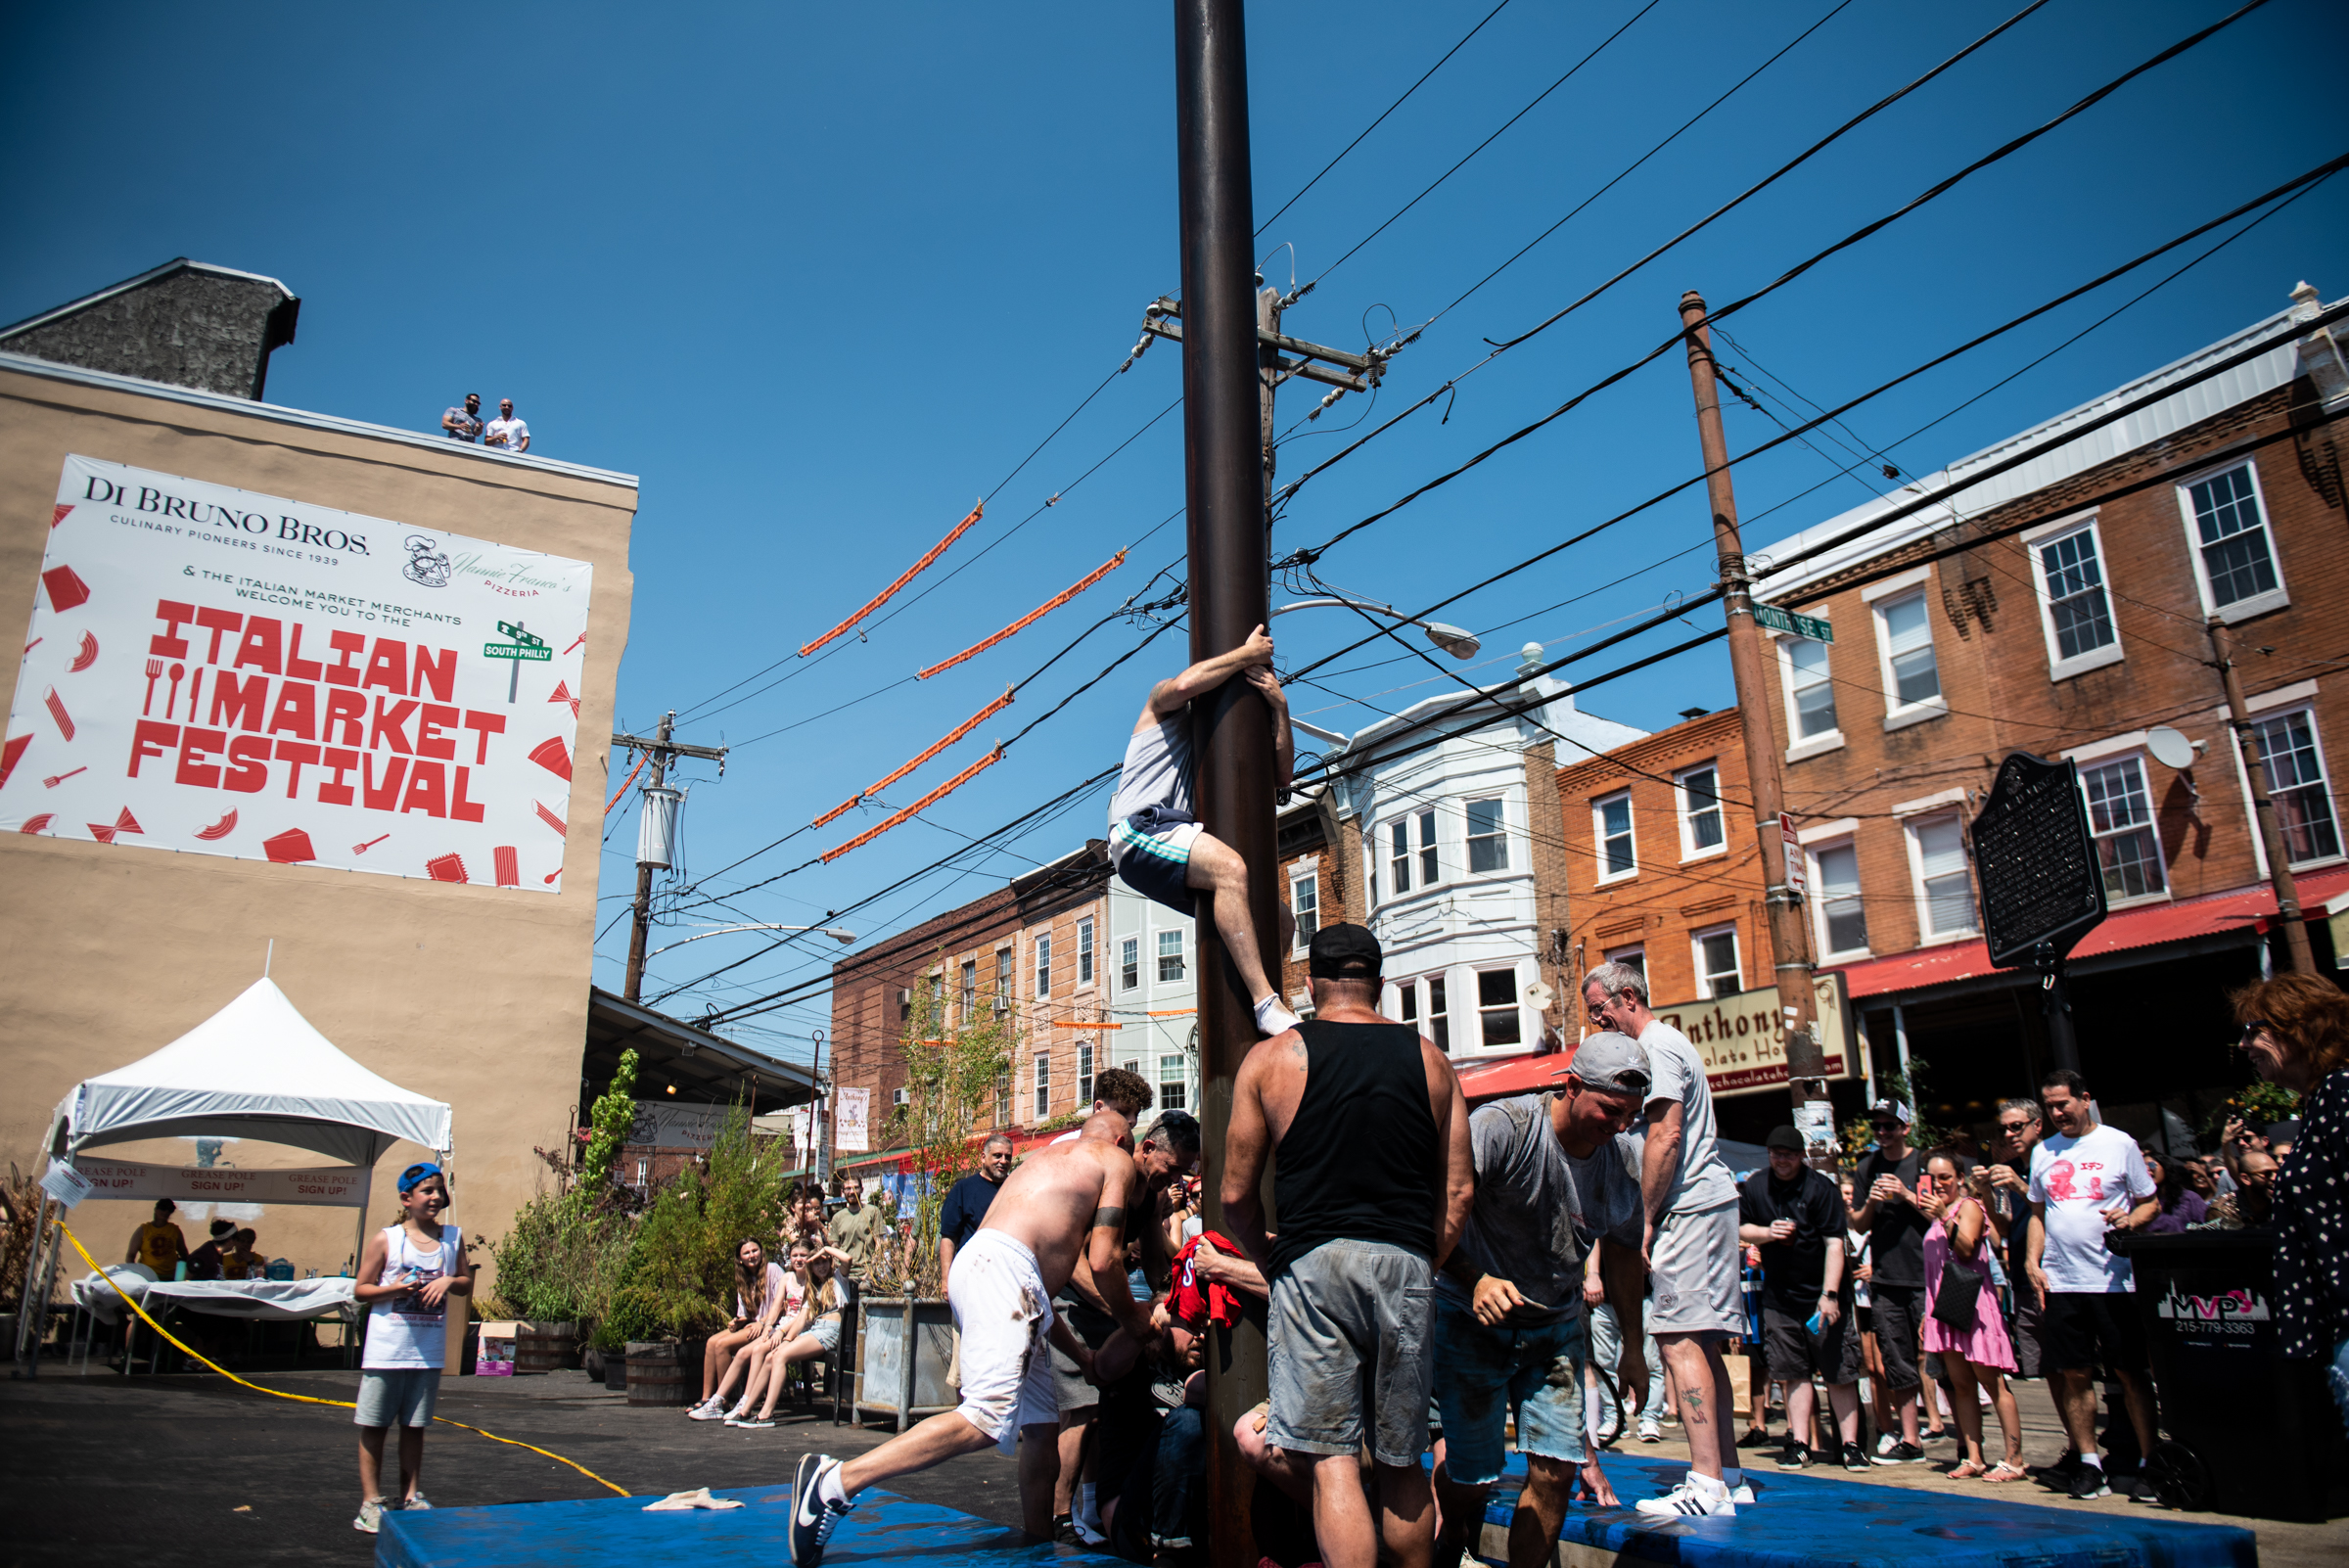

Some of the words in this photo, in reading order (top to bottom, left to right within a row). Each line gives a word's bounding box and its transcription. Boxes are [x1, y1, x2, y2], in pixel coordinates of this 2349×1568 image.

[134, 485, 269, 534] BRUNO
[275, 515, 372, 556] BROS.
[110, 514, 183, 535] CULINARY
[187, 530, 257, 550] PIONEERS
[262, 544, 303, 560] SINCE
[308, 553, 339, 566] 1939
[452, 552, 506, 579] Nannie
[507, 563, 574, 593] Franco's
[182, 565, 196, 577] &
[202, 570, 233, 583] THE
[239, 576, 299, 595] ITALIAN
[304, 589, 366, 608] MARKET
[370, 600, 463, 626] MERCHANTS
[484, 579, 539, 597] PIZZERIA
[235, 588, 314, 610] WELCOME
[319, 602, 350, 617] YOU
[355, 610, 376, 622] TO
[382, 614, 411, 627] THE
[1753, 606, 1817, 637] MONTROSE
[1820, 626, 1831, 641] ST
[149, 598, 458, 703] ITALIAN
[531, 636, 541, 647] ST
[484, 645, 518, 658] SOUTH
[518, 648, 551, 660] PHILLY
[209, 669, 507, 765] MARKET
[126, 719, 485, 824] FESTIVAL
[1704, 1046, 1747, 1067] olate
[681, 1130, 715, 1141] PIZZERI
[75, 1167, 114, 1176] REASE
[116, 1167, 147, 1177] POLE
[181, 1169, 228, 1180] GREASE
[229, 1170, 256, 1181] POLE
[2080, 1161, 2104, 1172] エデン
[112, 1178, 134, 1188] UP!
[190, 1180, 221, 1191] SIGN
[223, 1181, 245, 1192] UP!
[289, 1174, 331, 1184] GREASE
[332, 1175, 358, 1185] POLE
[297, 1184, 326, 1195] SIGN
[328, 1185, 347, 1196] UP!
[2171, 1295, 2239, 1320] MVP
[2175, 1320, 2255, 1335] 215-779-3363
